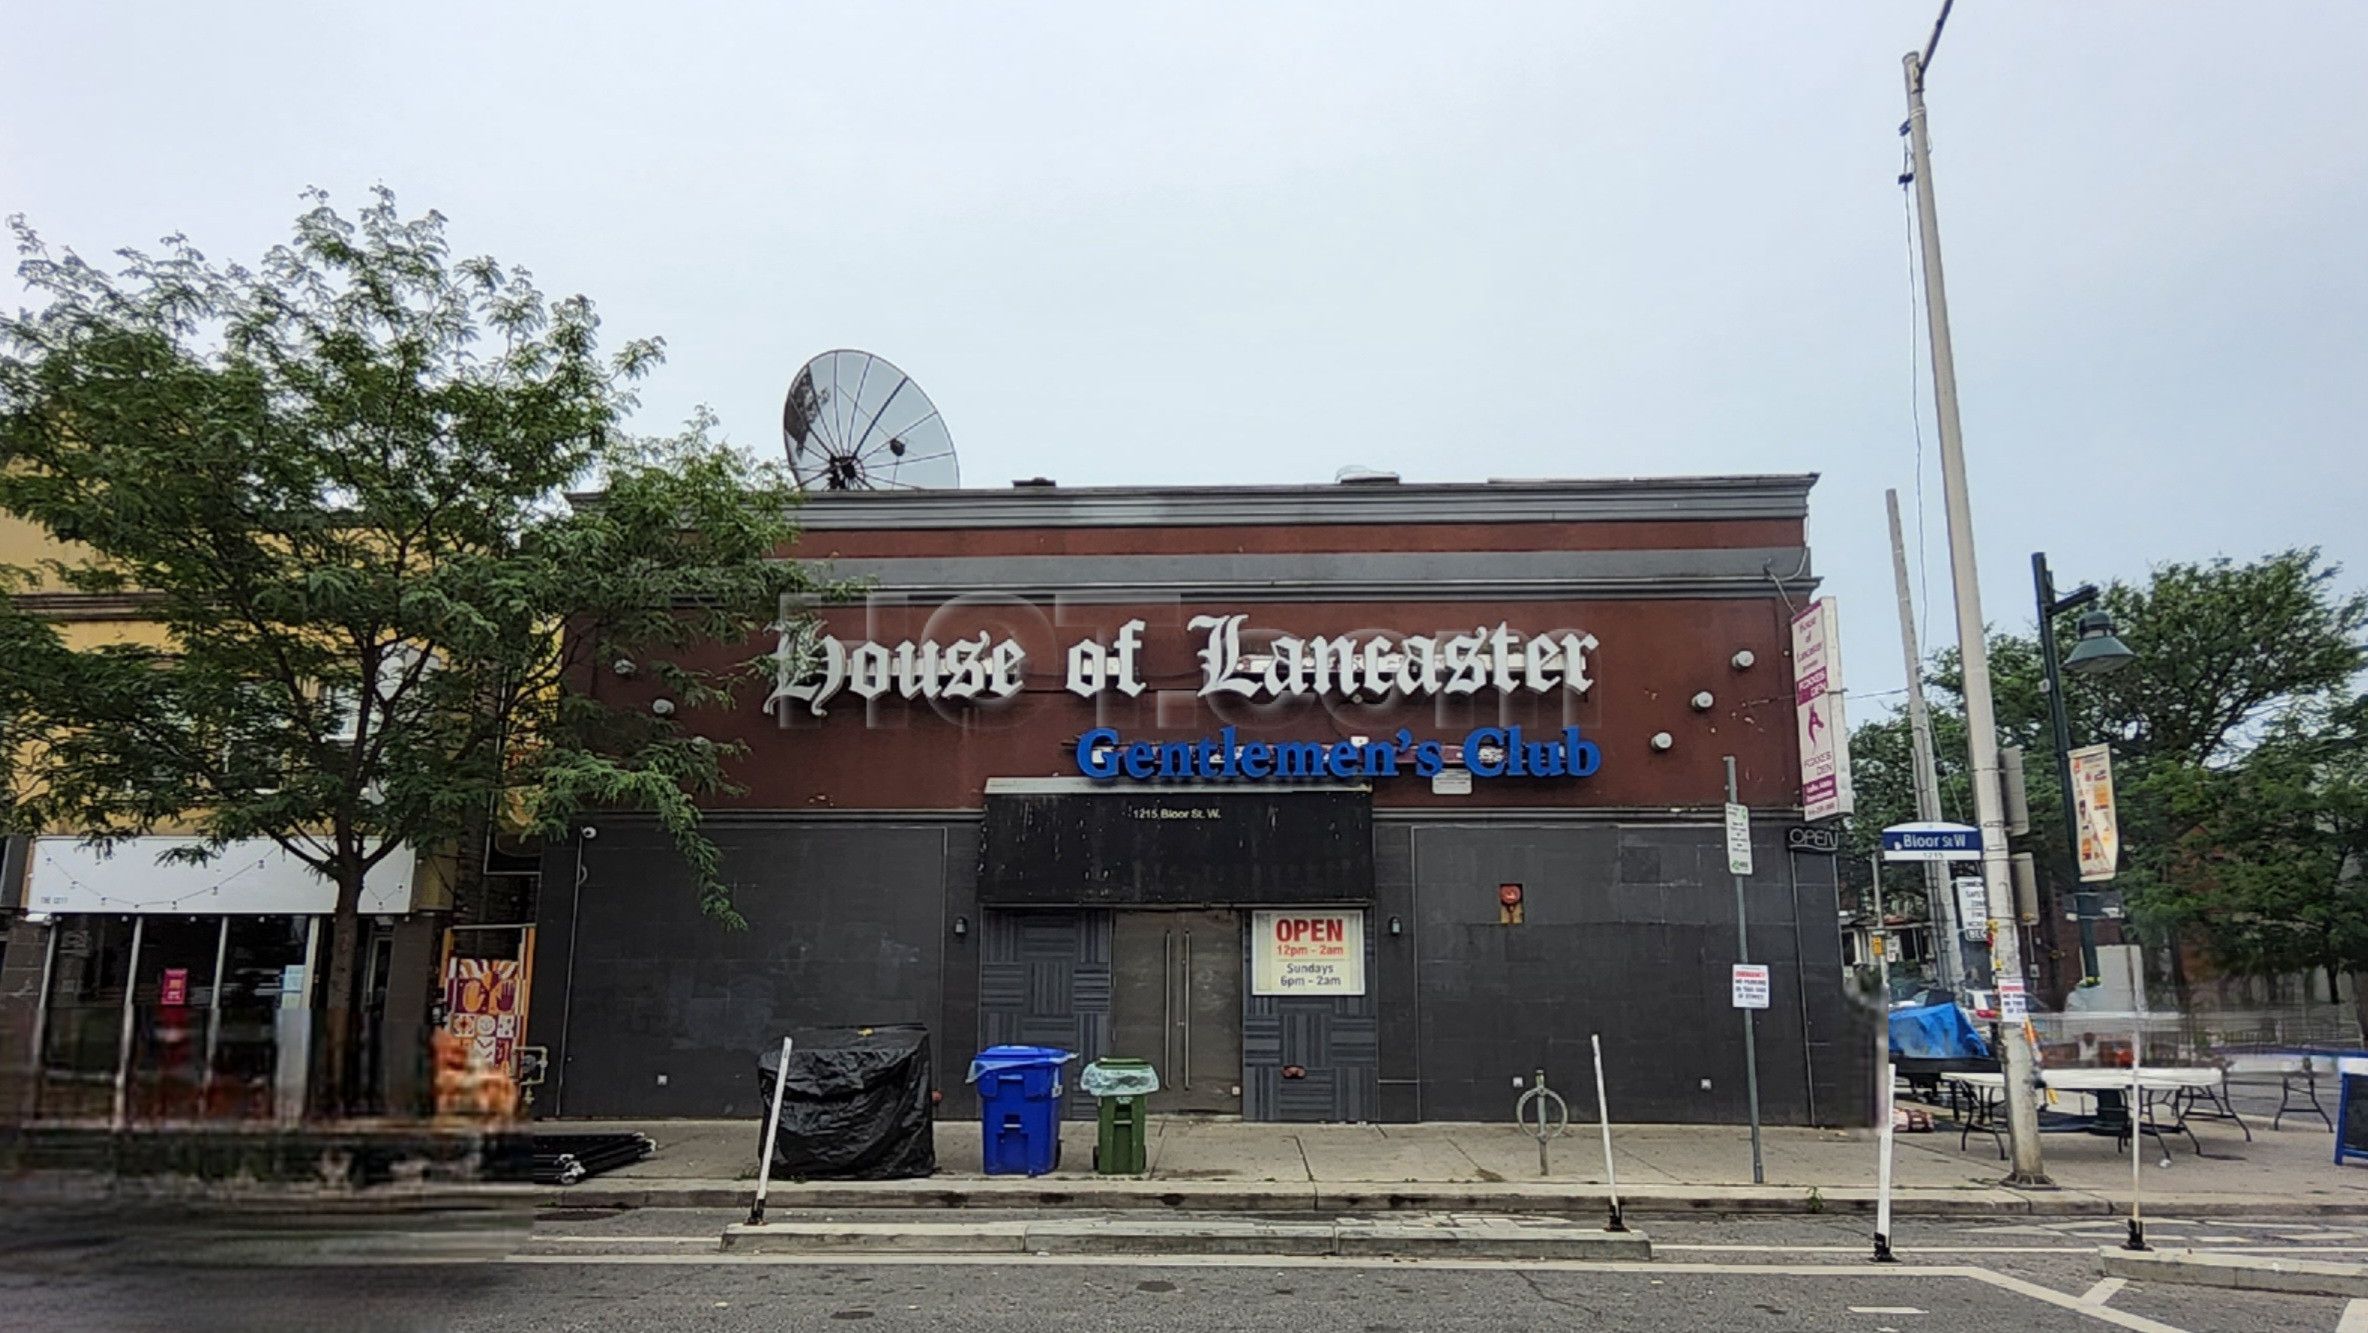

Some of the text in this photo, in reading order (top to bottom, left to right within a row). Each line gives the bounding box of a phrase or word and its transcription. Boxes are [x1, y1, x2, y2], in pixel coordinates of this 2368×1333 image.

[763, 614, 1600, 716] House of Lancaster
[1076, 724, 1602, 780] Gentlemen's Club
[1133, 808, 1158, 819] 1215
[1161, 808, 1189, 819] Bloor
[1206, 808, 1221, 819] W.
[1789, 828, 1839, 847] OPEN
[1903, 834, 1939, 848] Bloor
[1953, 834, 1966, 848] W
[1276, 918, 1344, 942] OPEN
[1277, 945, 1308, 957] 12pm
[1319, 945, 1344, 956] 2am
[1286, 963, 1334, 975] Sundays
[1280, 976, 1304, 988] 6pm
[1316, 976, 1341, 986] 2am
